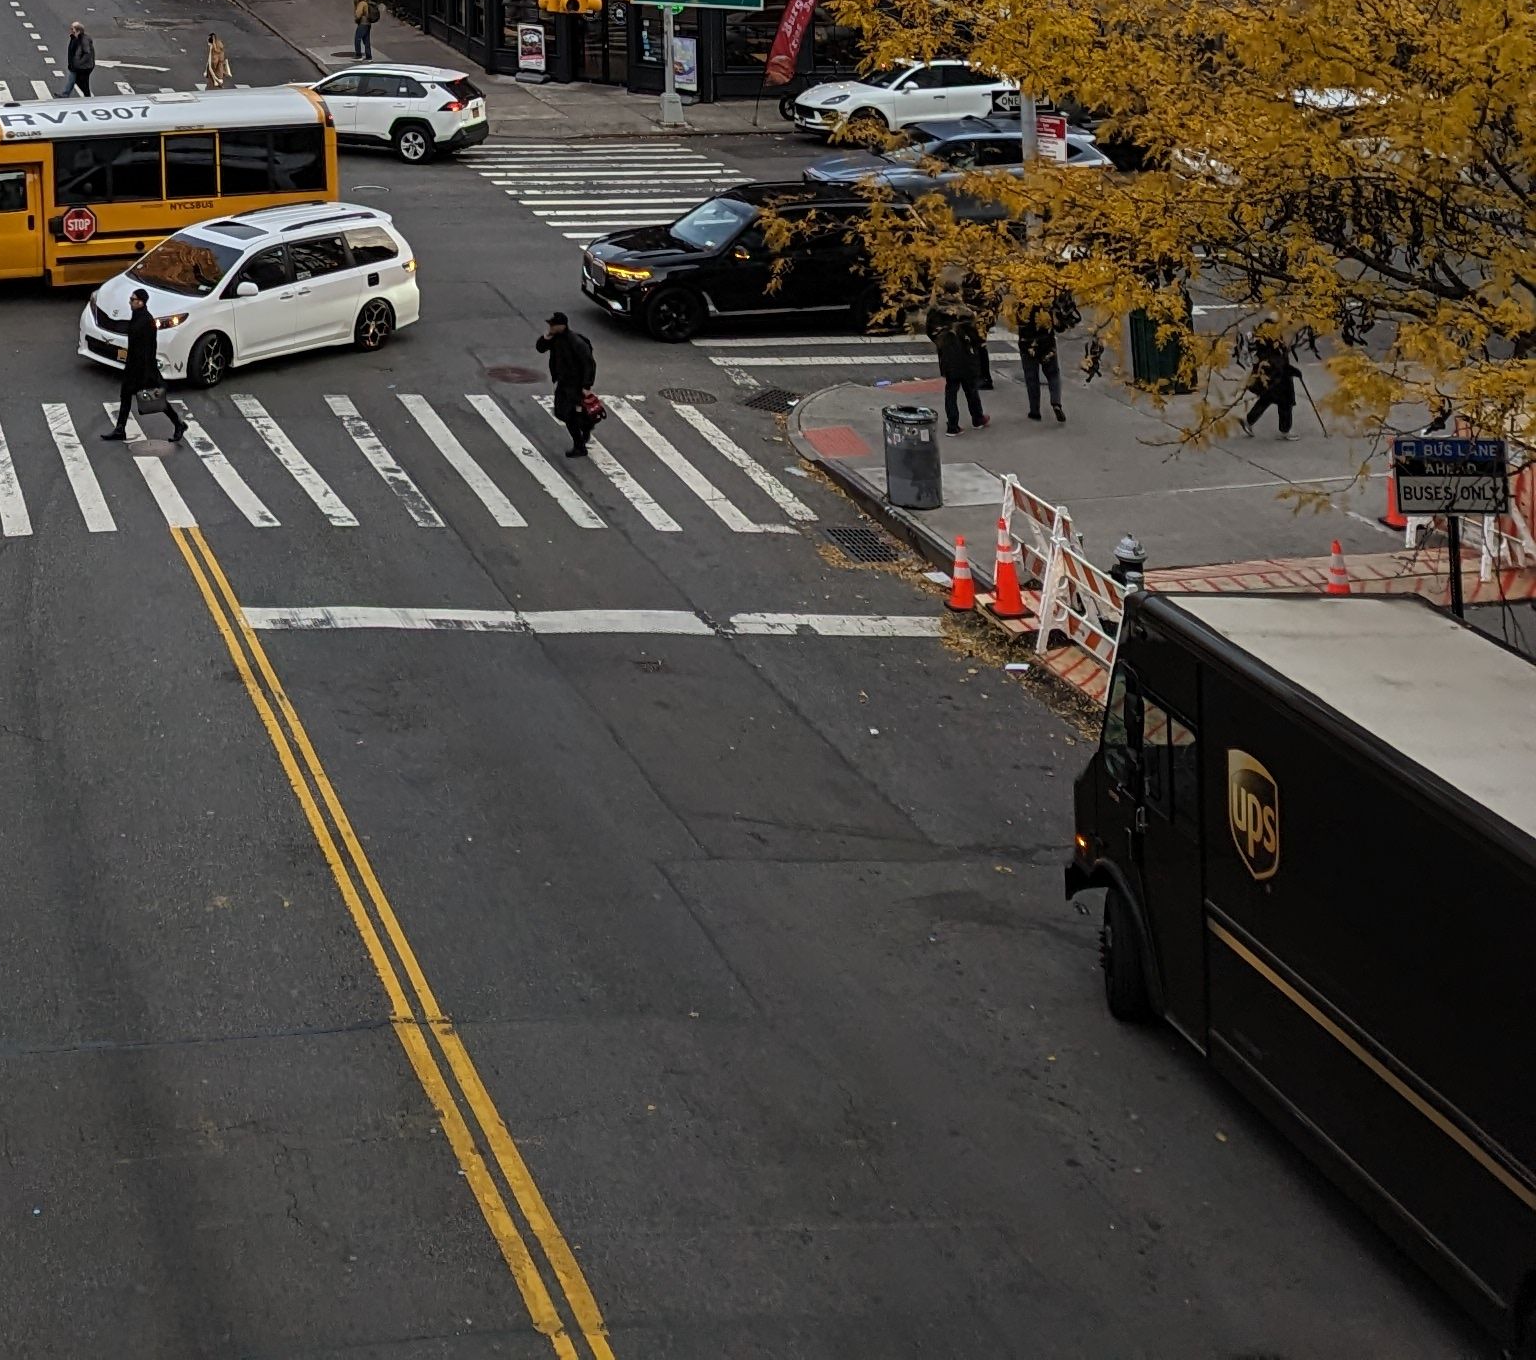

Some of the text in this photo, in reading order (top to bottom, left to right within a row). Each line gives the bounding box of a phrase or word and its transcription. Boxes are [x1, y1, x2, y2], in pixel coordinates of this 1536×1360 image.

[1001, 96, 1020, 106] ONE
[0, 105, 150, 127] RV1907
[16, 130, 41, 138] COLLINS
[67, 218, 91, 232] STOP
[1424, 444, 1452, 457] BUS
[1403, 486, 1501, 501] BUSES ONLY
[1232, 781, 1276, 859] ups
